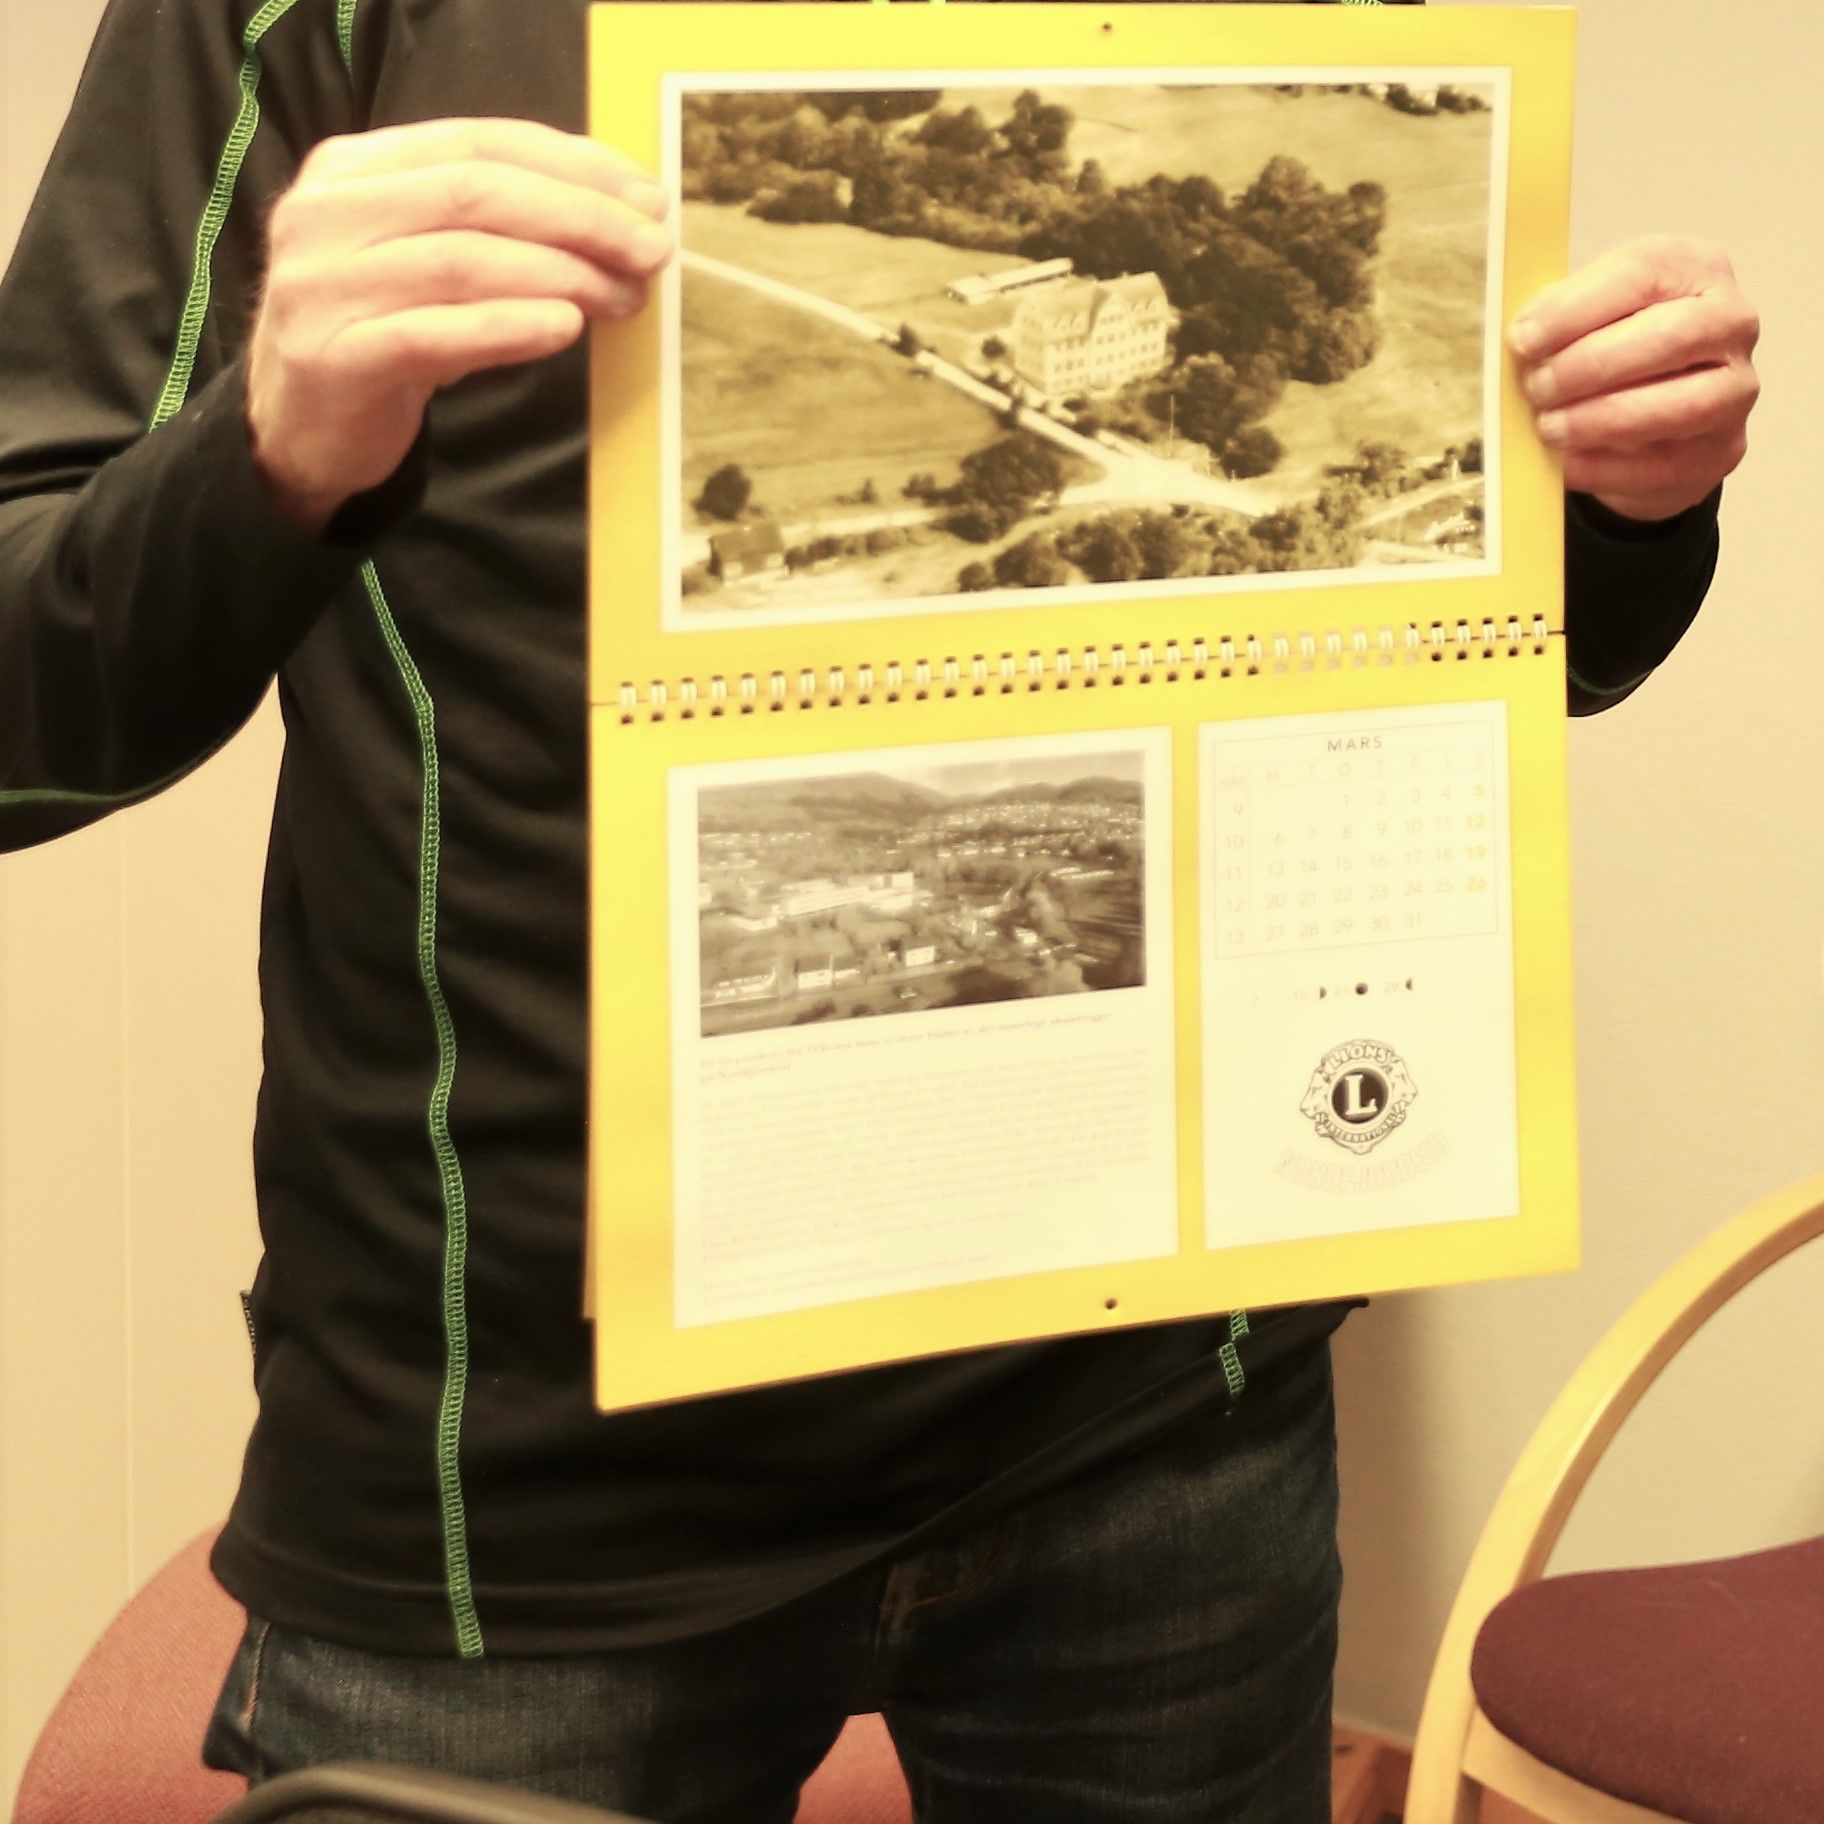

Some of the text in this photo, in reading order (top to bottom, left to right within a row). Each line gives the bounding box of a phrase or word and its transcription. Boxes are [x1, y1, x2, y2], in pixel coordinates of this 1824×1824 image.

[1327, 734, 1383, 752] MARS
[1329, 1045, 1393, 1069] LIONS
[1344, 1074, 1378, 1116] L
